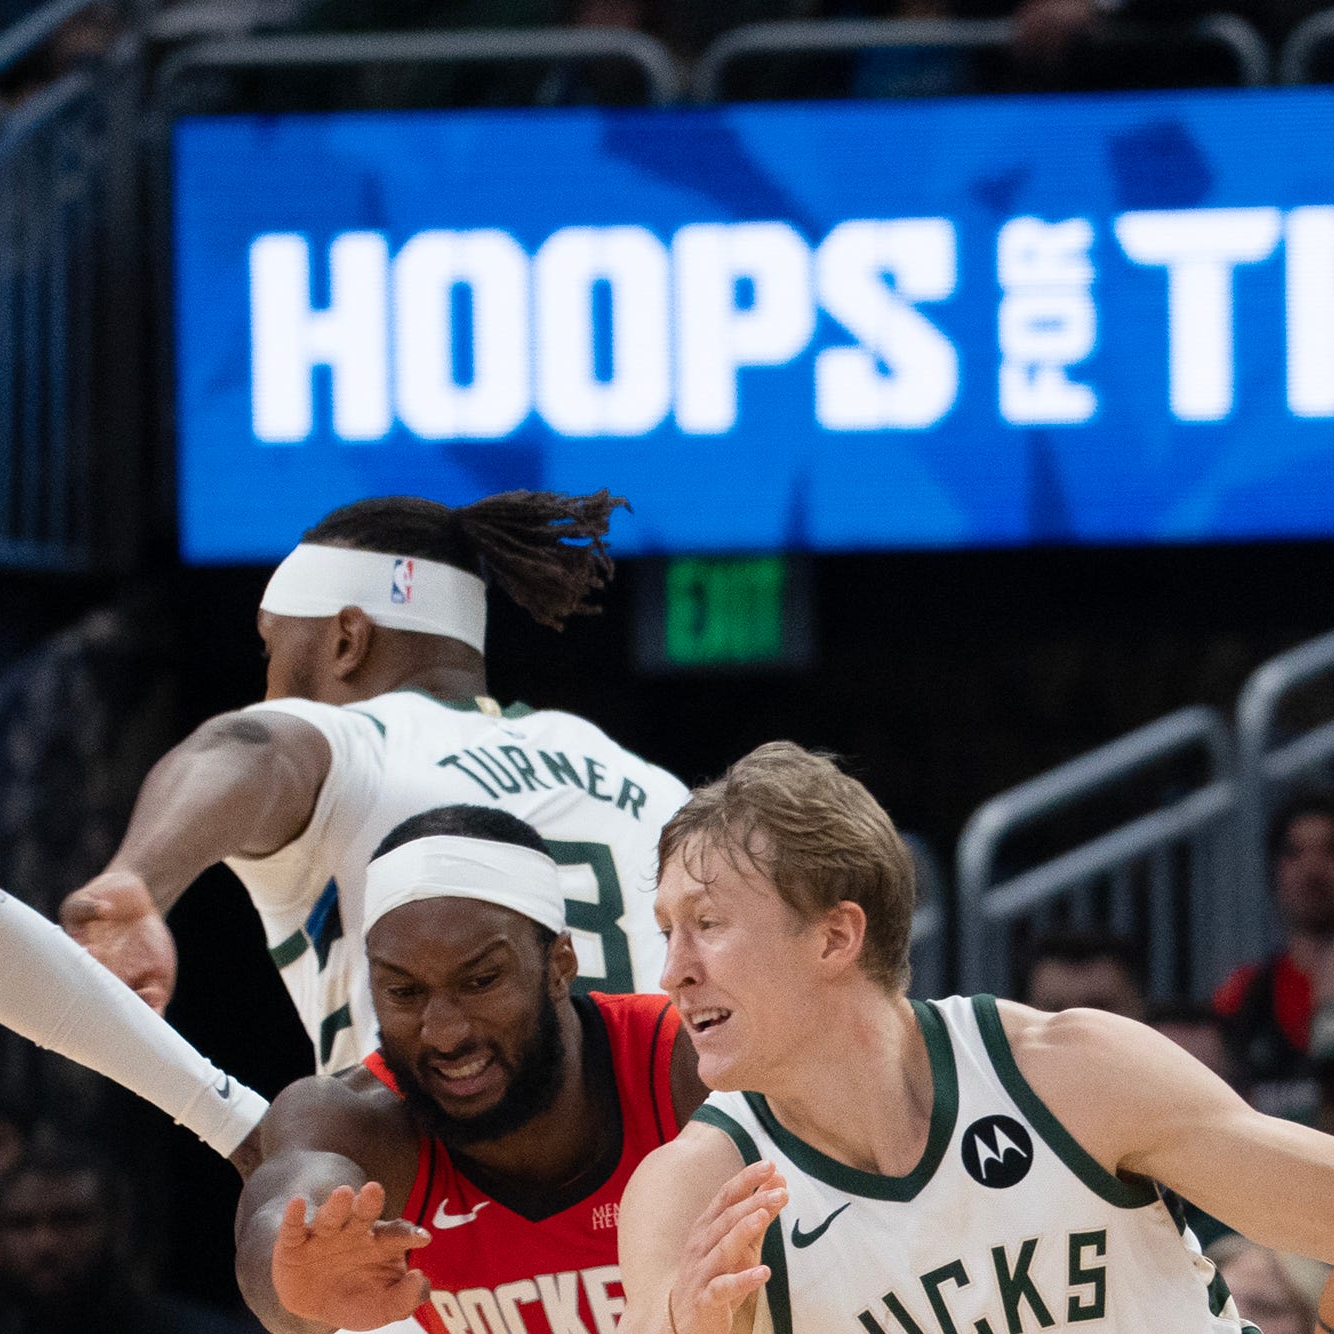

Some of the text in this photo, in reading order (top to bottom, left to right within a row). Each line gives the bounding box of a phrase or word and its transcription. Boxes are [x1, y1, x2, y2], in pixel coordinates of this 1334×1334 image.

[250, 217, 958, 441] HOOPS
[997, 215, 1097, 425] FOR
[437, 745, 647, 820] TURNER
